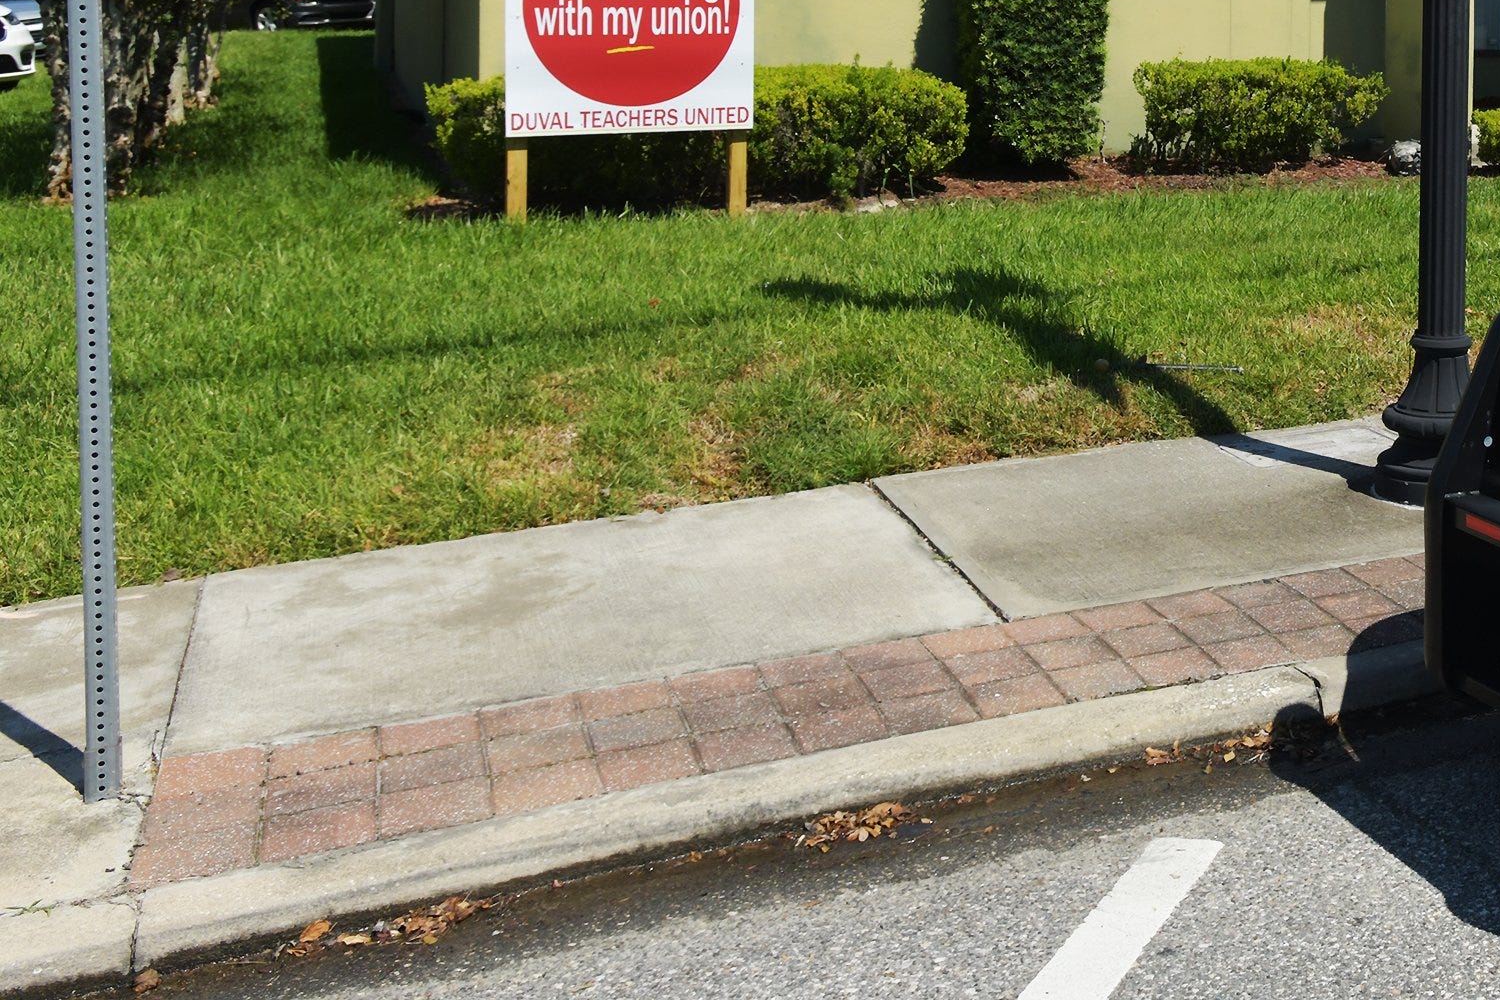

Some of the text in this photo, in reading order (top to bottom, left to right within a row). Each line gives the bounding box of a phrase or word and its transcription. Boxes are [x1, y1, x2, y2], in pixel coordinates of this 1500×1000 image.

[602, 5, 643, 44] my
[511, 106, 750, 131] DUVAL TEACHERS UNITED
